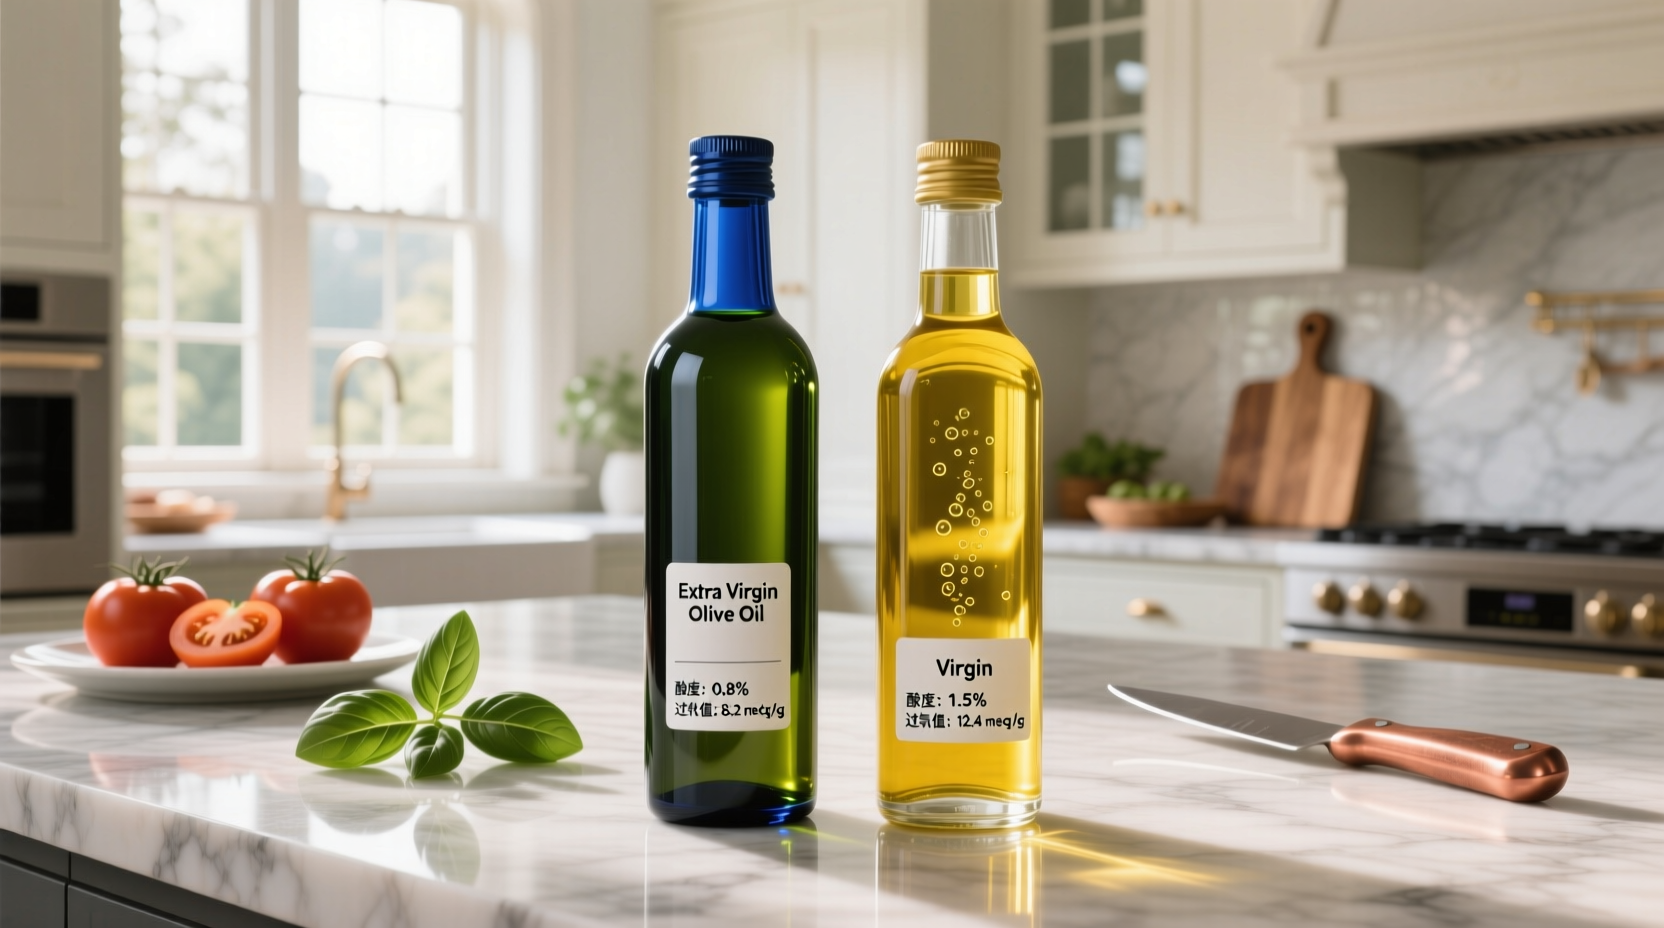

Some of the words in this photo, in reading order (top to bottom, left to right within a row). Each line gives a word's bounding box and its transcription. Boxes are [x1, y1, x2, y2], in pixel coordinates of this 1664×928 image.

[678, 582, 722, 600] Extra
[725, 581, 778, 604] Virgin
[688, 604, 735, 622] Olive
[738, 604, 764, 622] Oil
[935, 658, 993, 682] Virgin
[711, 681, 750, 697] 0.8%
[948, 691, 988, 708] 1.5%
[956, 713, 983, 728] 12.4
[985, 712, 1026, 730] meq/g
